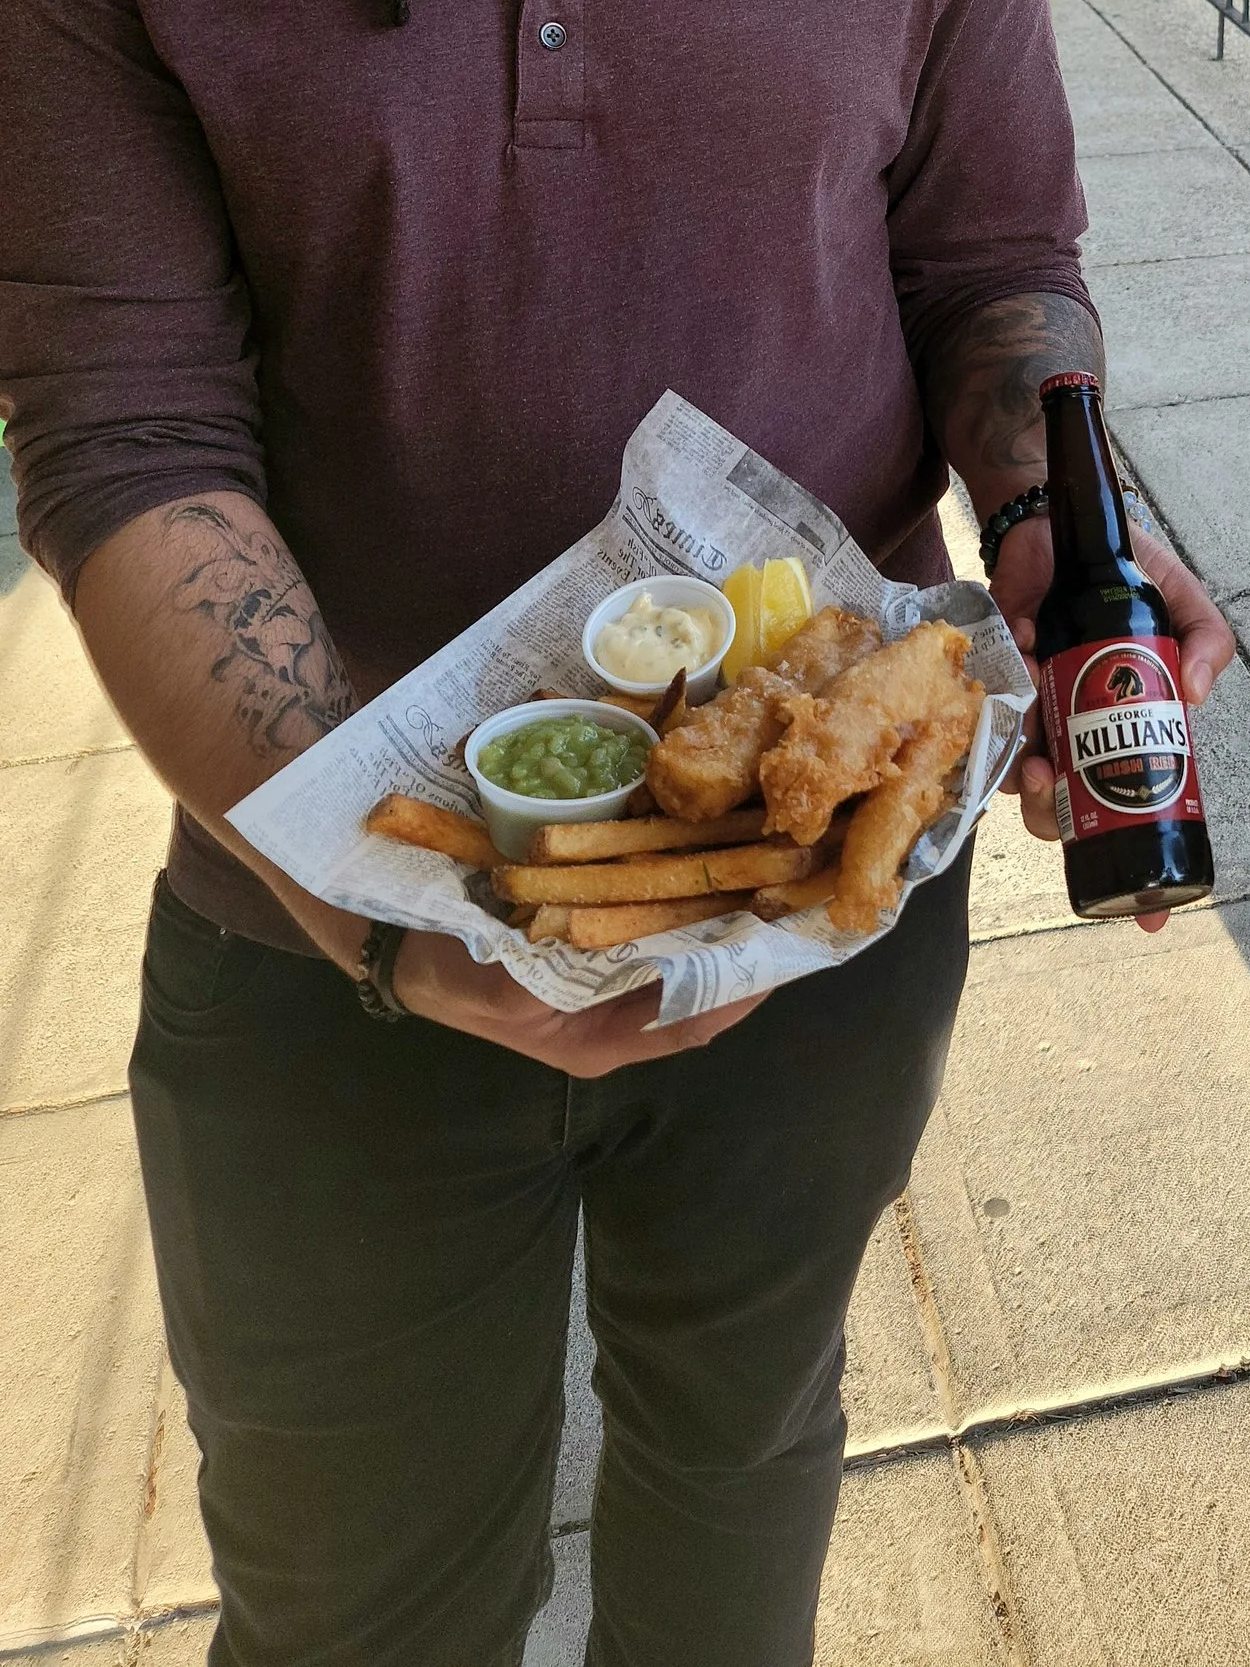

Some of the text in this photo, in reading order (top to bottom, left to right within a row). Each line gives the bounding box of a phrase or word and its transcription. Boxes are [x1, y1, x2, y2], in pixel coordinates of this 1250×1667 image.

[1108, 708, 1154, 723] GEORGE
[1075, 718, 1187, 761] KILLIAN'S
[1097, 755, 1179, 779] IRISH RED
